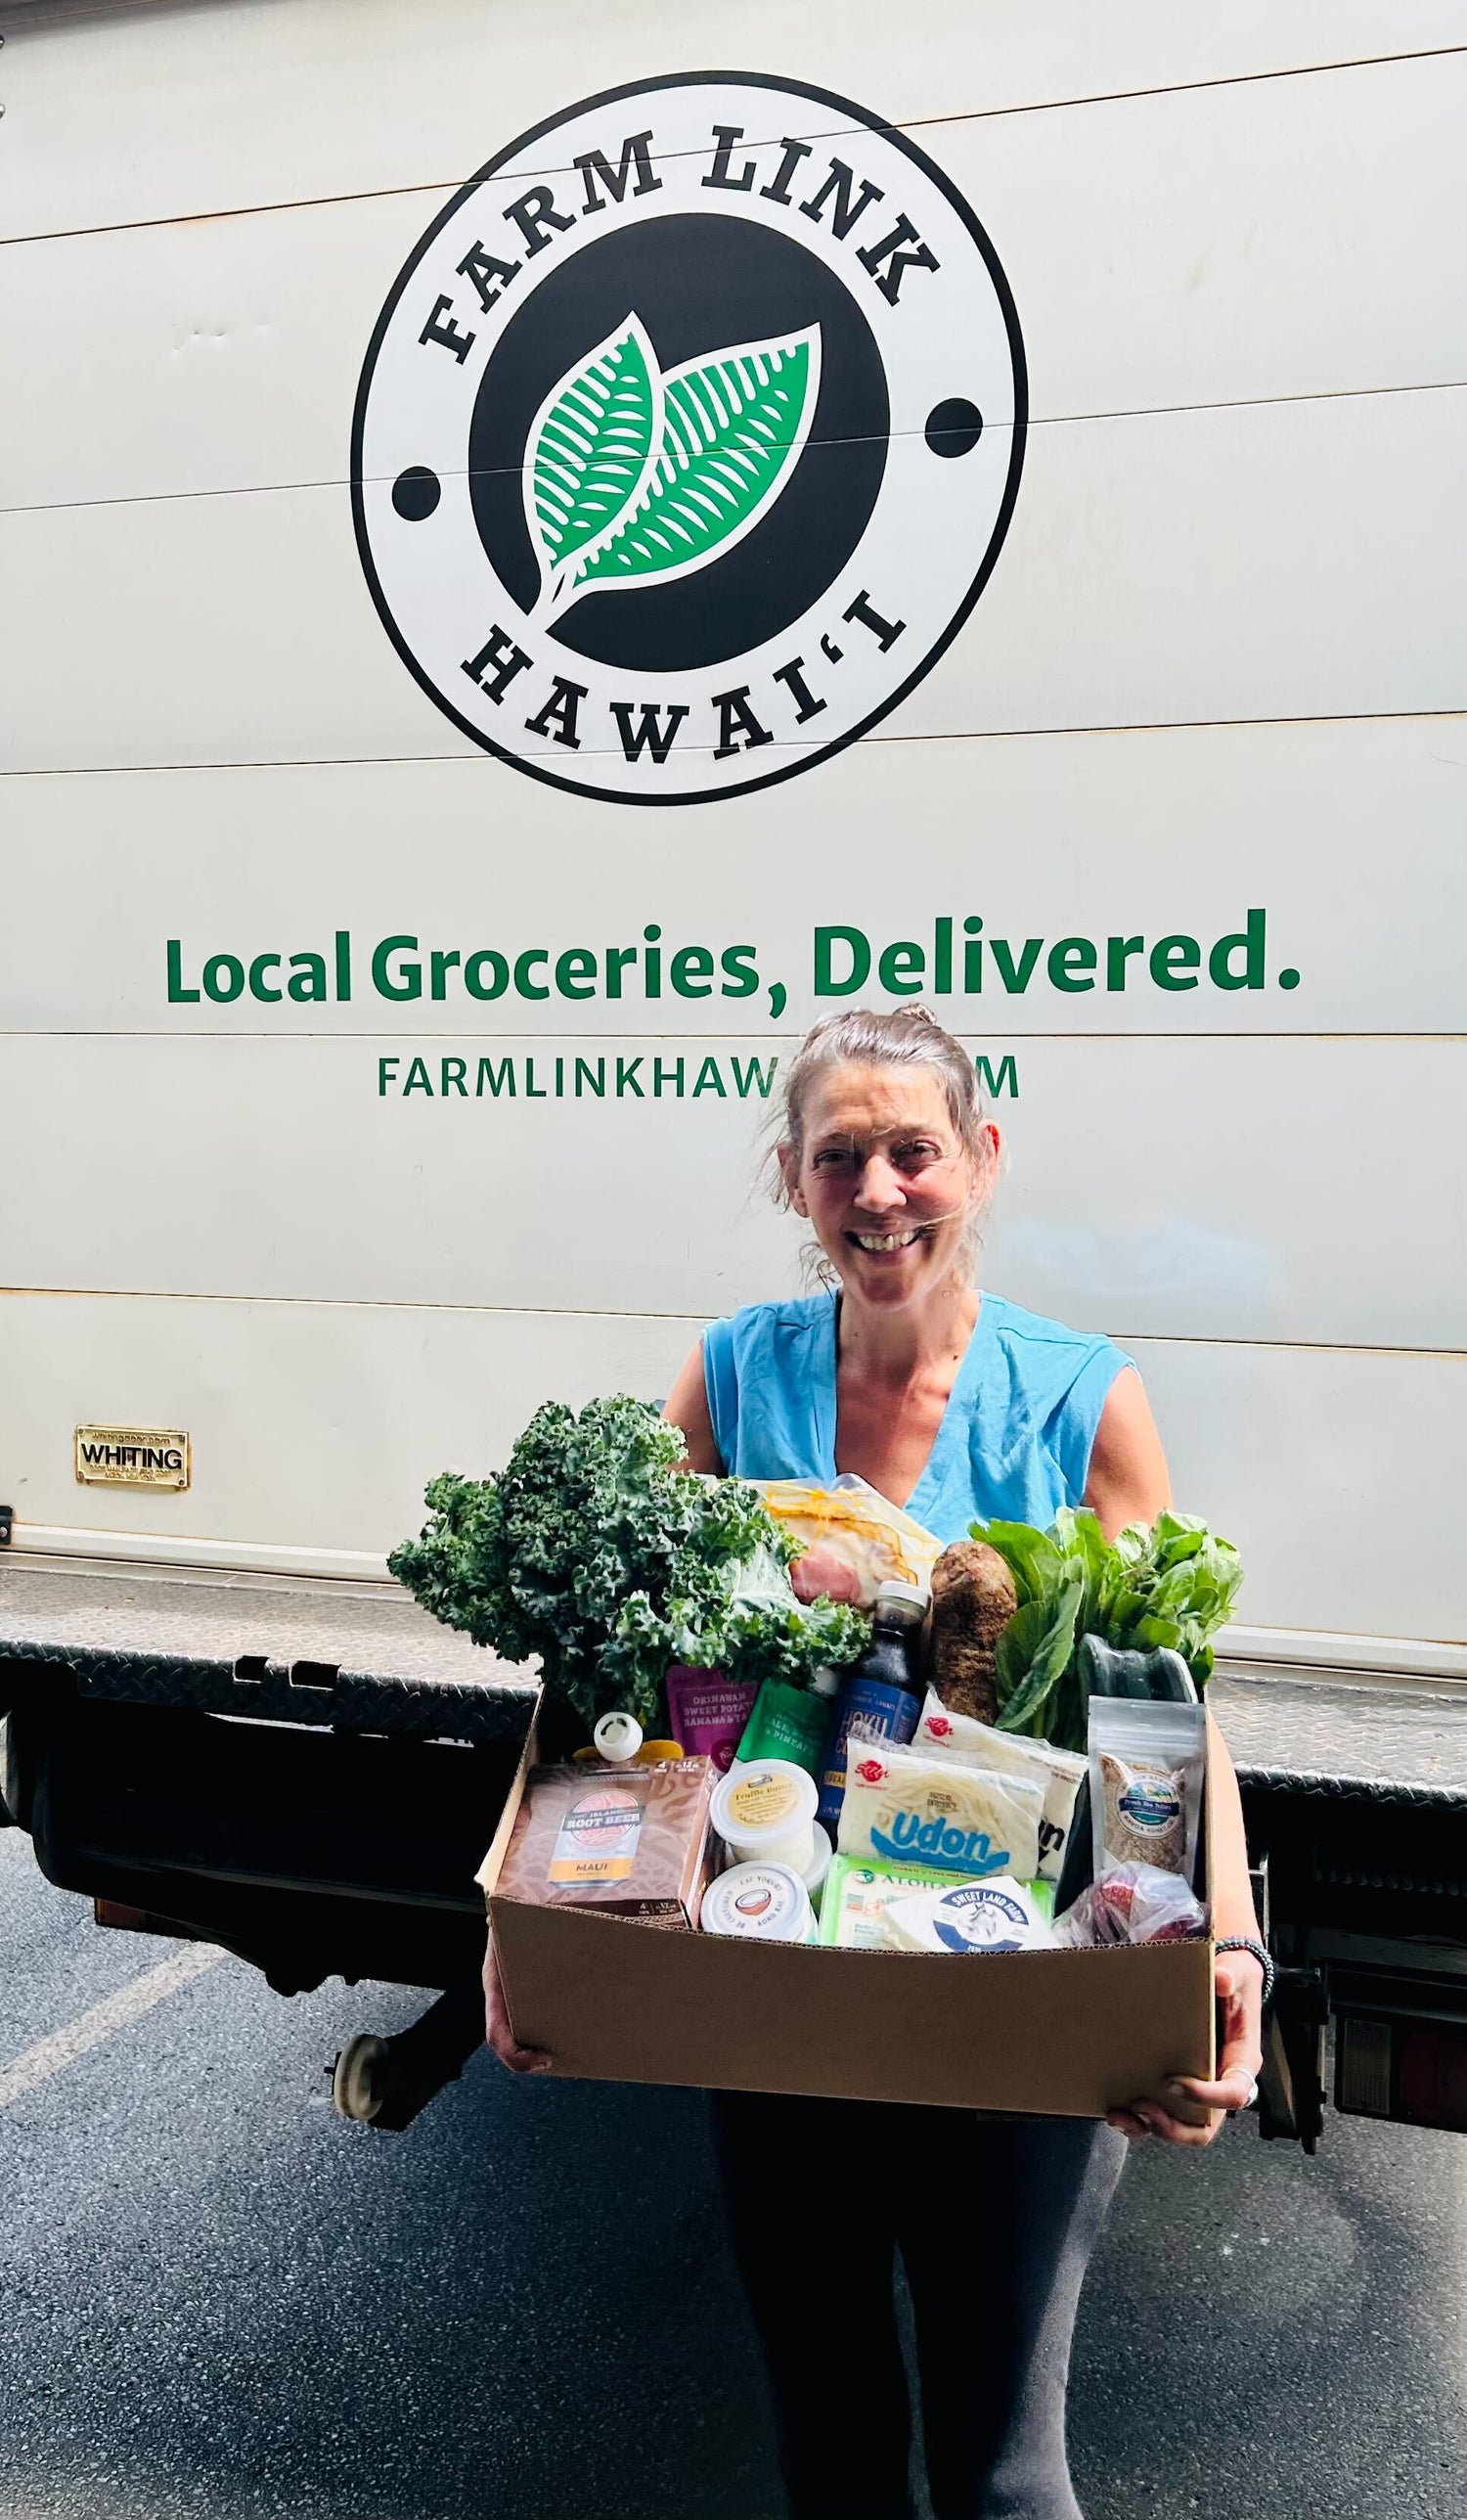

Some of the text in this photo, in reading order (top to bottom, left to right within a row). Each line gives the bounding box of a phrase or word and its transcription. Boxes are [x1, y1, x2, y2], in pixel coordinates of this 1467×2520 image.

[419, 125, 941, 365] FARM LINK
[168, 909, 1301, 1018] Local Groceries, Delivered.
[378, 1056, 1019, 1098] FARMLINKHAWM
[80, 1442, 183, 1470] WHITING
[684, 1706, 718, 1716] SWEET
[566, 1813, 641, 1829] ROOT BEER
[892, 1811, 991, 1860] Udon
[576, 1863, 608, 1871] MAUI
[952, 1891, 1025, 1922] SWEET LAND FARM
